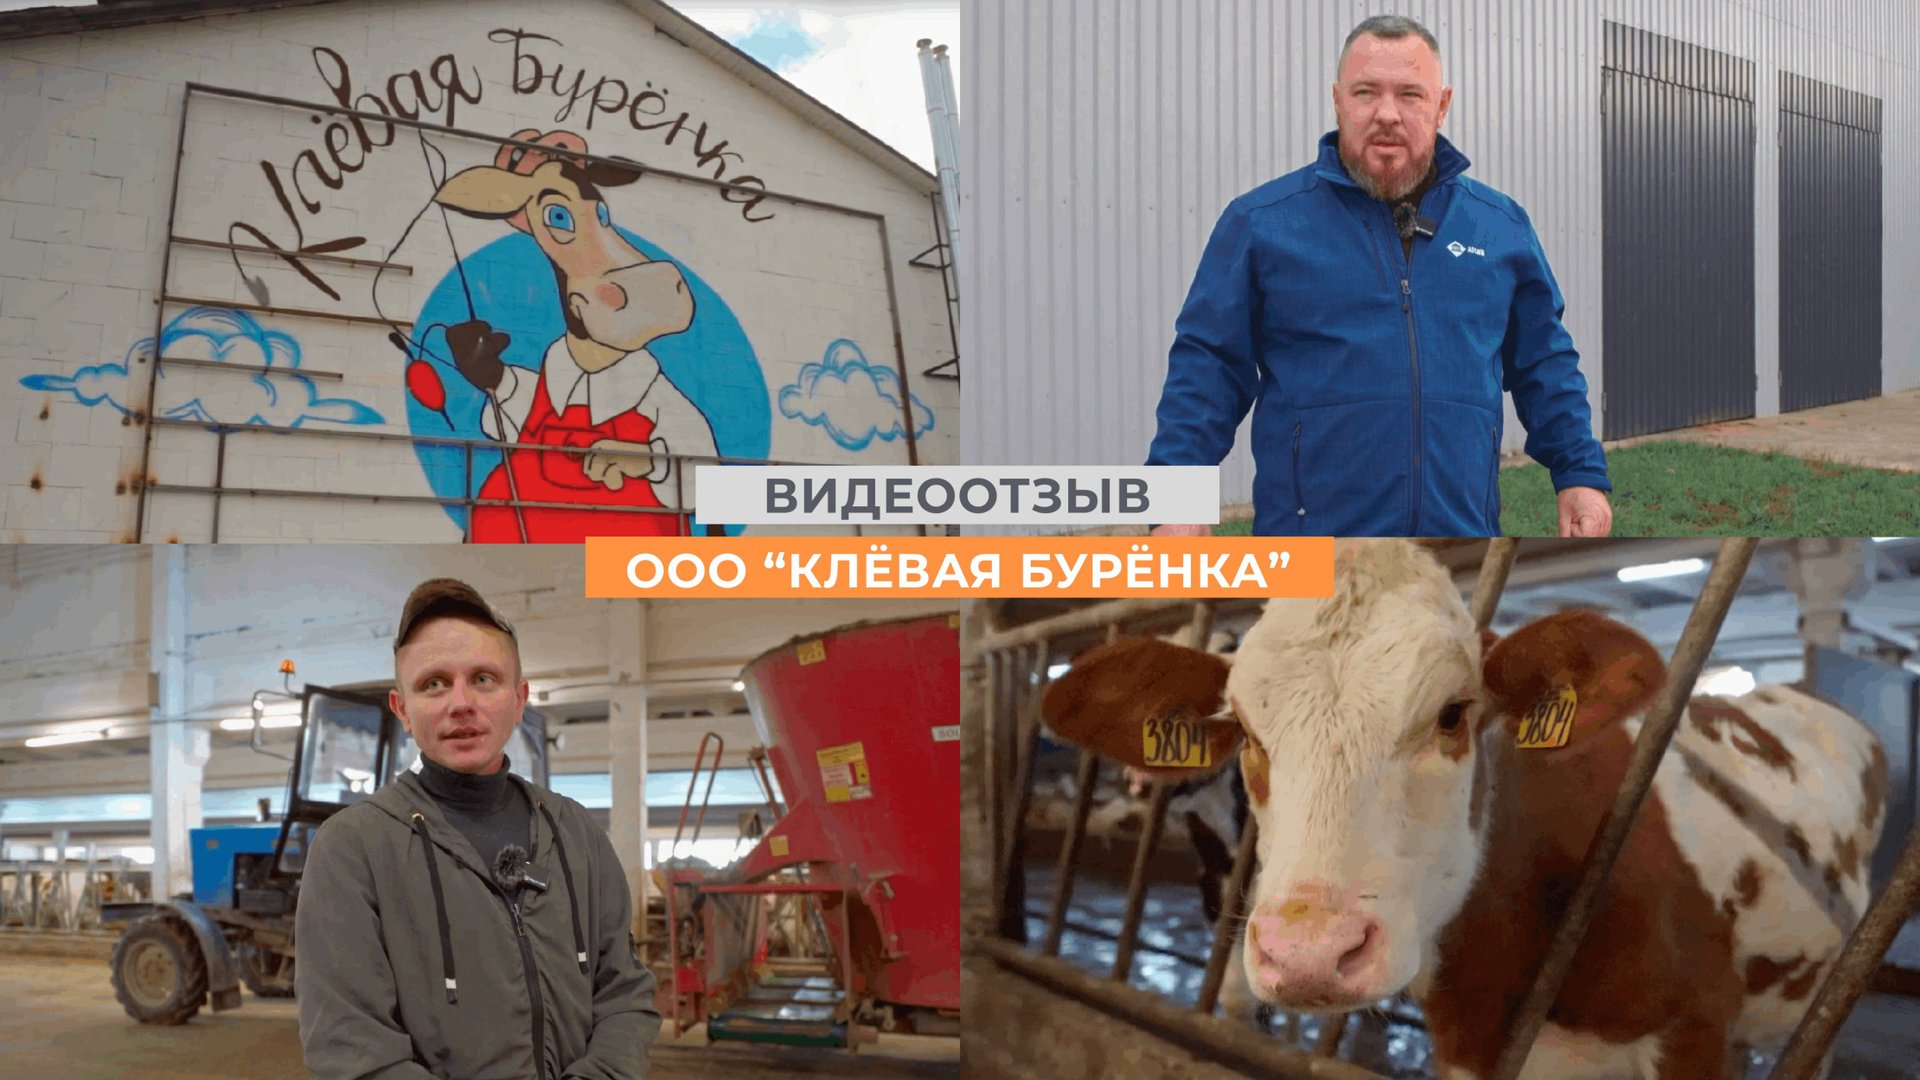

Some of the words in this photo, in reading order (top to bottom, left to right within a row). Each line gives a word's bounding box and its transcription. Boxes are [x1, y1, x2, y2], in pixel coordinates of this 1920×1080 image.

[229, 47, 483, 301] Клёвая
[487, 28, 776, 222] Бурёнка
[1145, 719, 1207, 764] 3804
